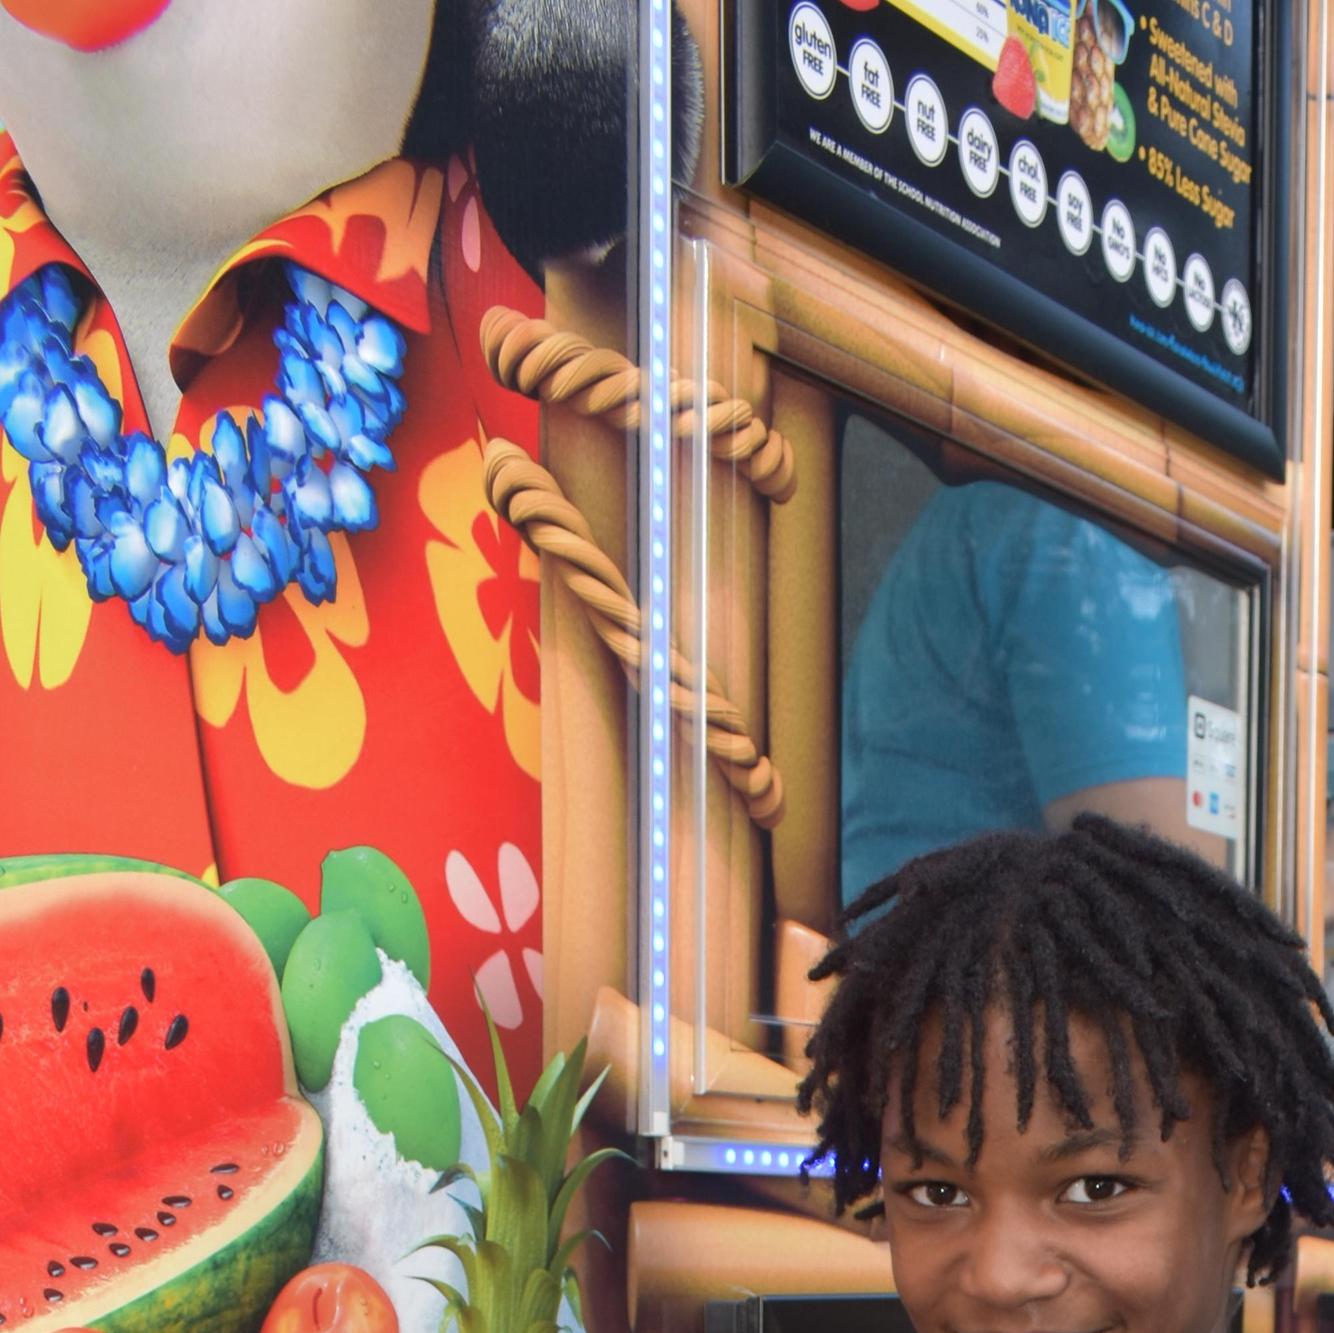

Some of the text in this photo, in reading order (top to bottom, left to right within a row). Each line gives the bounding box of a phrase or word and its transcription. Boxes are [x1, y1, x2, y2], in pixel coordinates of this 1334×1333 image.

[794, 22, 832, 60] gluten
[1212, 10, 1222, 39] &
[1223, 19, 1234, 47] D
[802, 48, 824, 77] FREE
[863, 61, 880, 88] fat
[1149, 16, 1238, 110] Sweetened with
[861, 83, 881, 110] FREE
[917, 99, 935, 123] nut
[1149, 52, 1247, 148] All-Natural Stevia
[916, 118, 936, 142] FREE
[966, 128, 992, 161] dairy
[1147, 85, 1253, 185] & Pure Cane Sugar
[809, 126, 822, 146] WE
[822, 133, 837, 155] ARE
[842, 147, 874, 176] MEMBER
[873, 165, 884, 180] OF
[883, 170, 899, 190] THE
[898, 179, 925, 205] SCHOOL
[968, 150, 988, 174] FREE
[1019, 180, 1038, 204] FREE
[1148, 146, 1235, 229] 85% Less Sugar
[1068, 192, 1084, 214] soy
[1066, 211, 1083, 233] FREE
